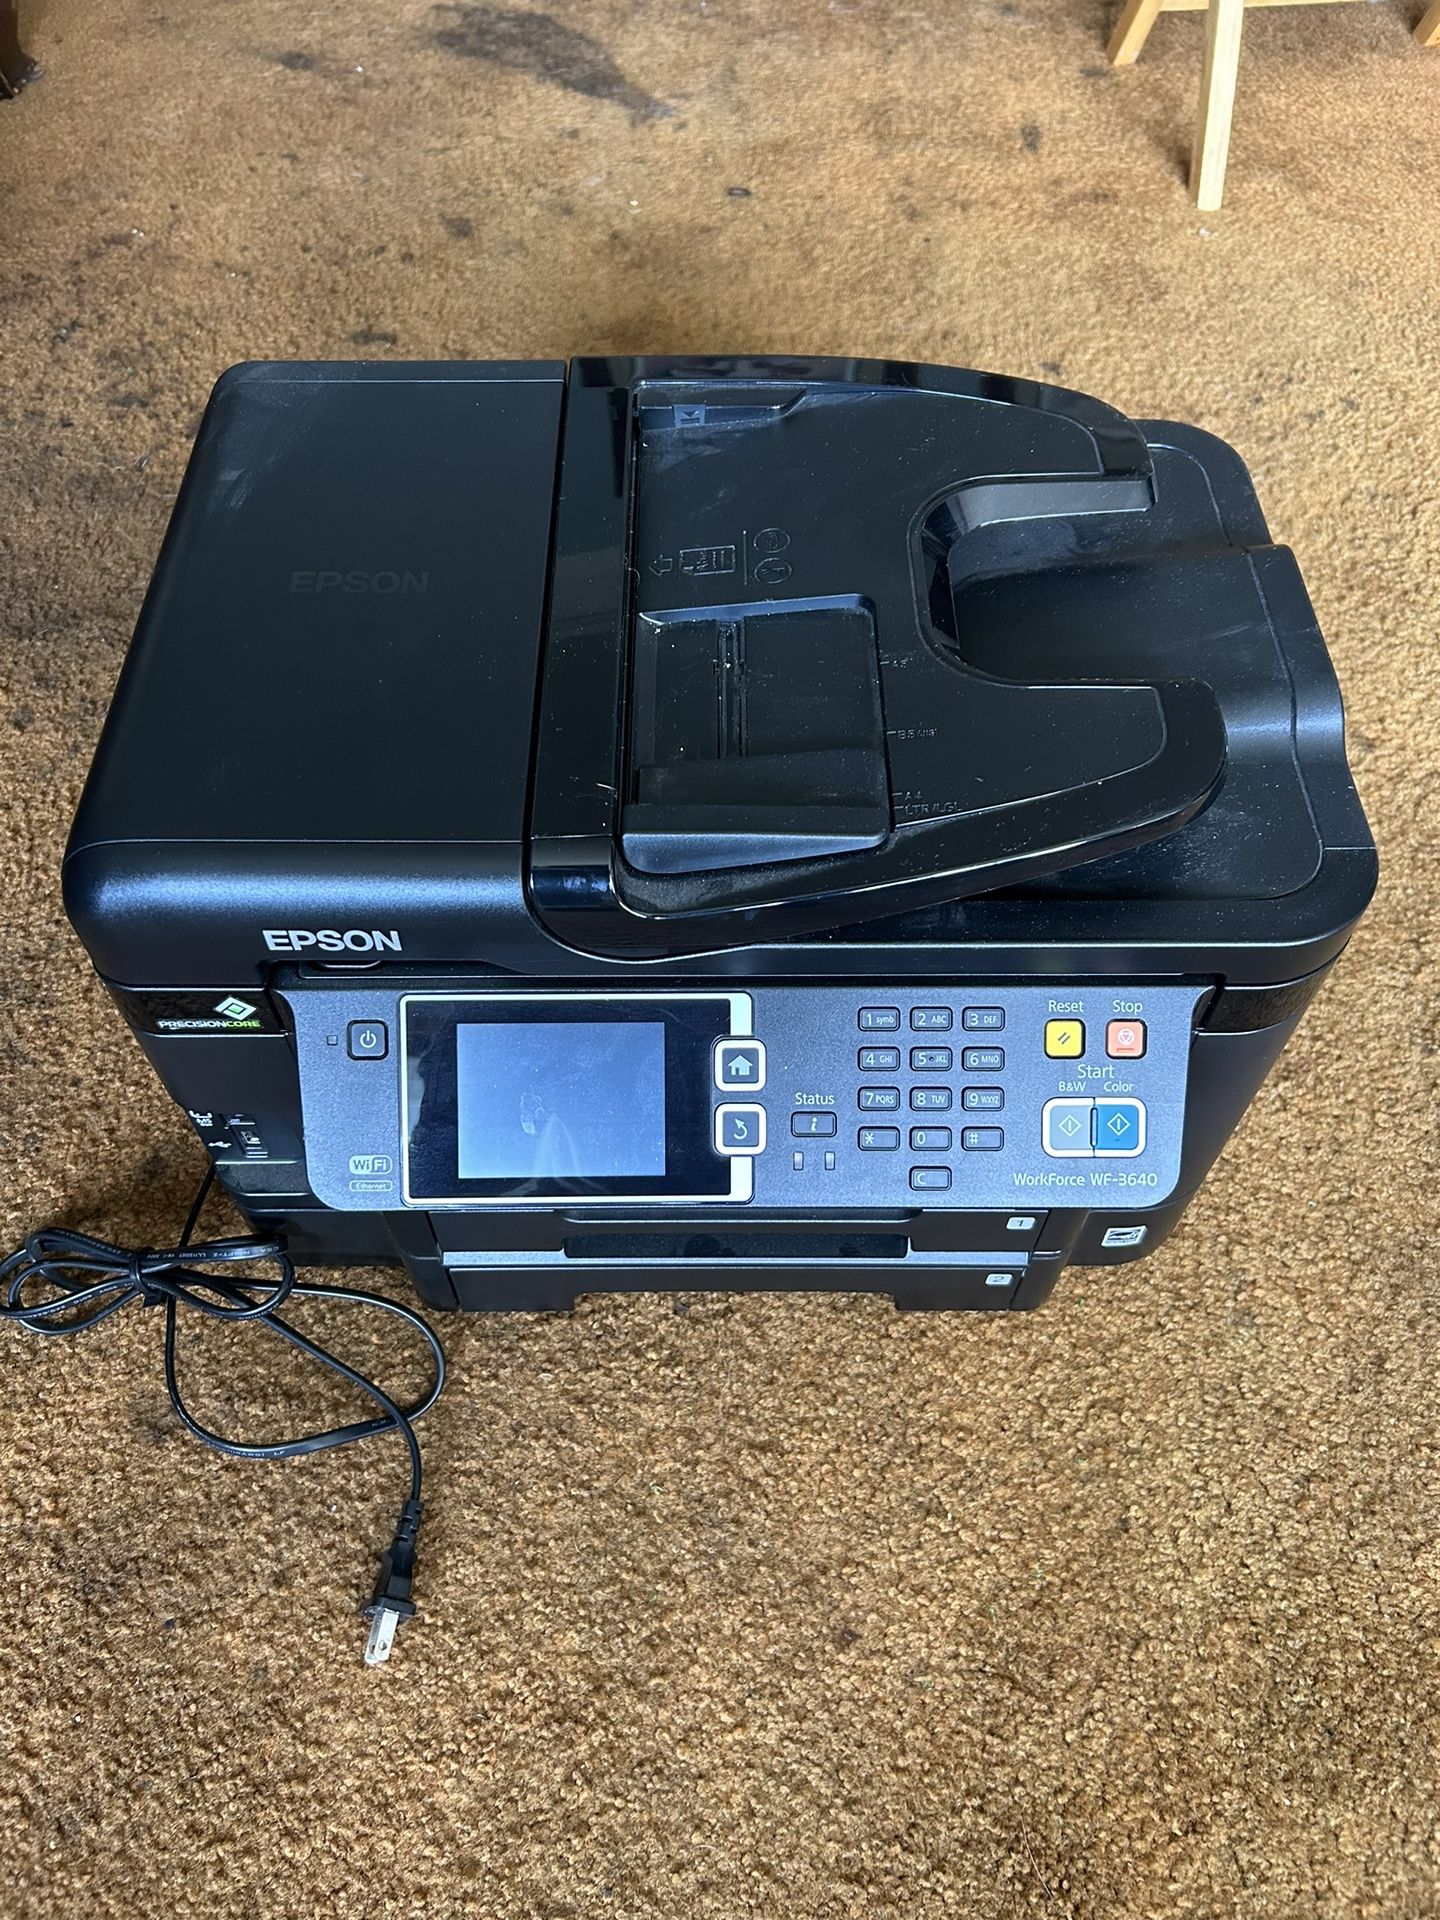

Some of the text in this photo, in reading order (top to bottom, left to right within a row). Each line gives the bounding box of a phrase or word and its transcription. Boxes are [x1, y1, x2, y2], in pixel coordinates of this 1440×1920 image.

[289, 570, 430, 594] EPSON
[262, 929, 403, 951] EPSON
[1048, 1000, 1084, 1012] Reset
[1112, 1000, 1143, 1015] Stop
[866, 1014, 894, 1025] 1 symb
[918, 1014, 946, 1025] 2 ABC
[970, 1014, 998, 1025] 3 DEF
[866, 1053, 893, 1065] 4 GHI
[918, 1053, 947, 1065] 5 JKL
[970, 1053, 999, 1065] 6 MNO
[1077, 1064, 1115, 1078] Start
[1058, 1081, 1087, 1092] B&W
[1103, 1081, 1134, 1092] Color
[795, 1092, 835, 1104] Status
[865, 1093, 894, 1104] 7 PQRS
[917, 1093, 945, 1104] 8 TUV
[969, 1093, 999, 1104] 9 WXYZ
[917, 1132, 926, 1144] 0
[969, 1132, 979, 1143] #
[917, 1173, 926, 1185] C
[1013, 1173, 1158, 1186] WorkForce WF-3640
